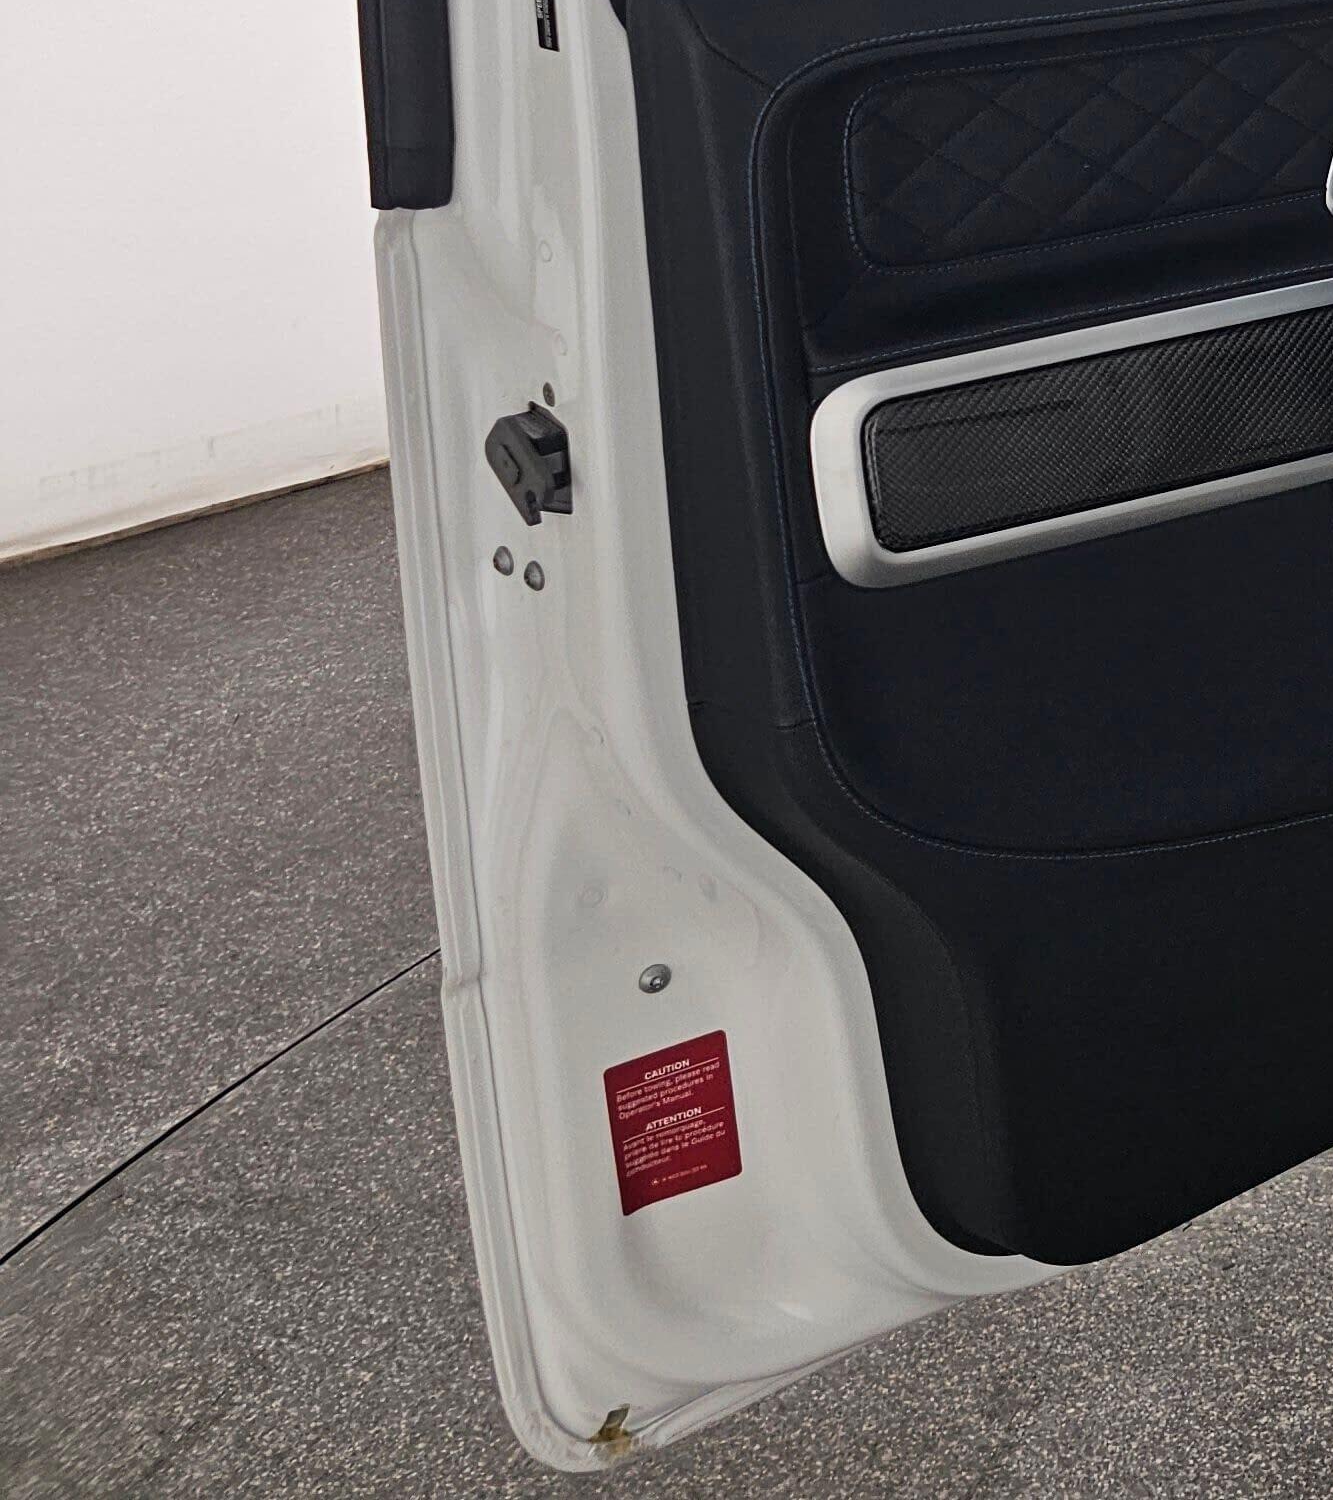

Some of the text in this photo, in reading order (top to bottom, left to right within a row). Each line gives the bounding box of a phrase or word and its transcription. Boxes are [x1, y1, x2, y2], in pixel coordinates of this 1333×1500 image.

[644, 1059, 690, 1080] CAUTION
[617, 1089, 642, 1102] Before
[675, 1069, 700, 1083] please
[703, 1061, 720, 1072] read
[660, 1078, 704, 1098] procedures
[646, 1106, 702, 1131] ATTENTION
